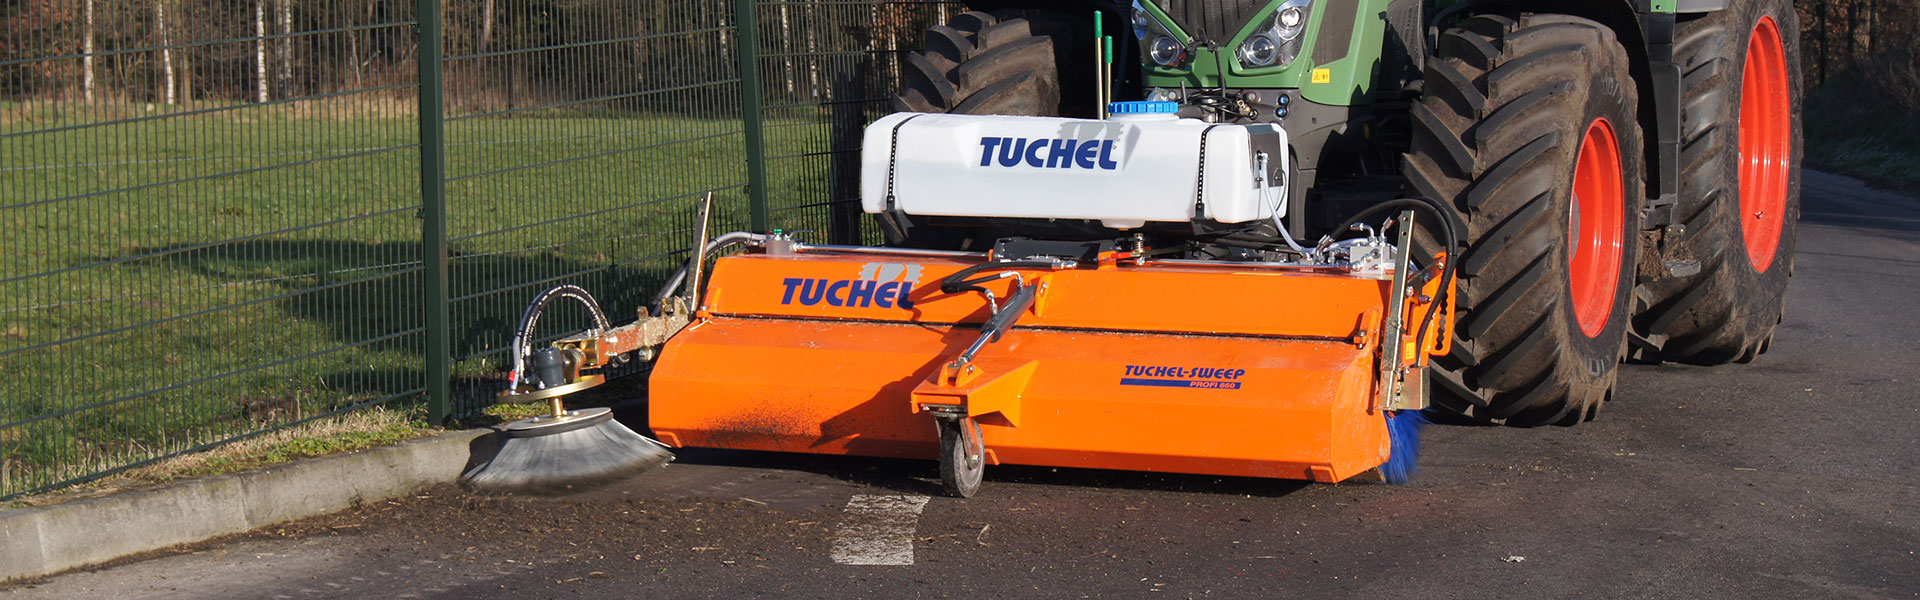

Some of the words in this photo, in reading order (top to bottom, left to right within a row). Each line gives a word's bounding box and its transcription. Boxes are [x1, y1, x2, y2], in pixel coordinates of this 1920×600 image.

[979, 136, 1118, 170] TUCHEL
[781, 277, 915, 310] TUCHEL
[1125, 365, 1246, 380] TUCHEL-SWEEP
